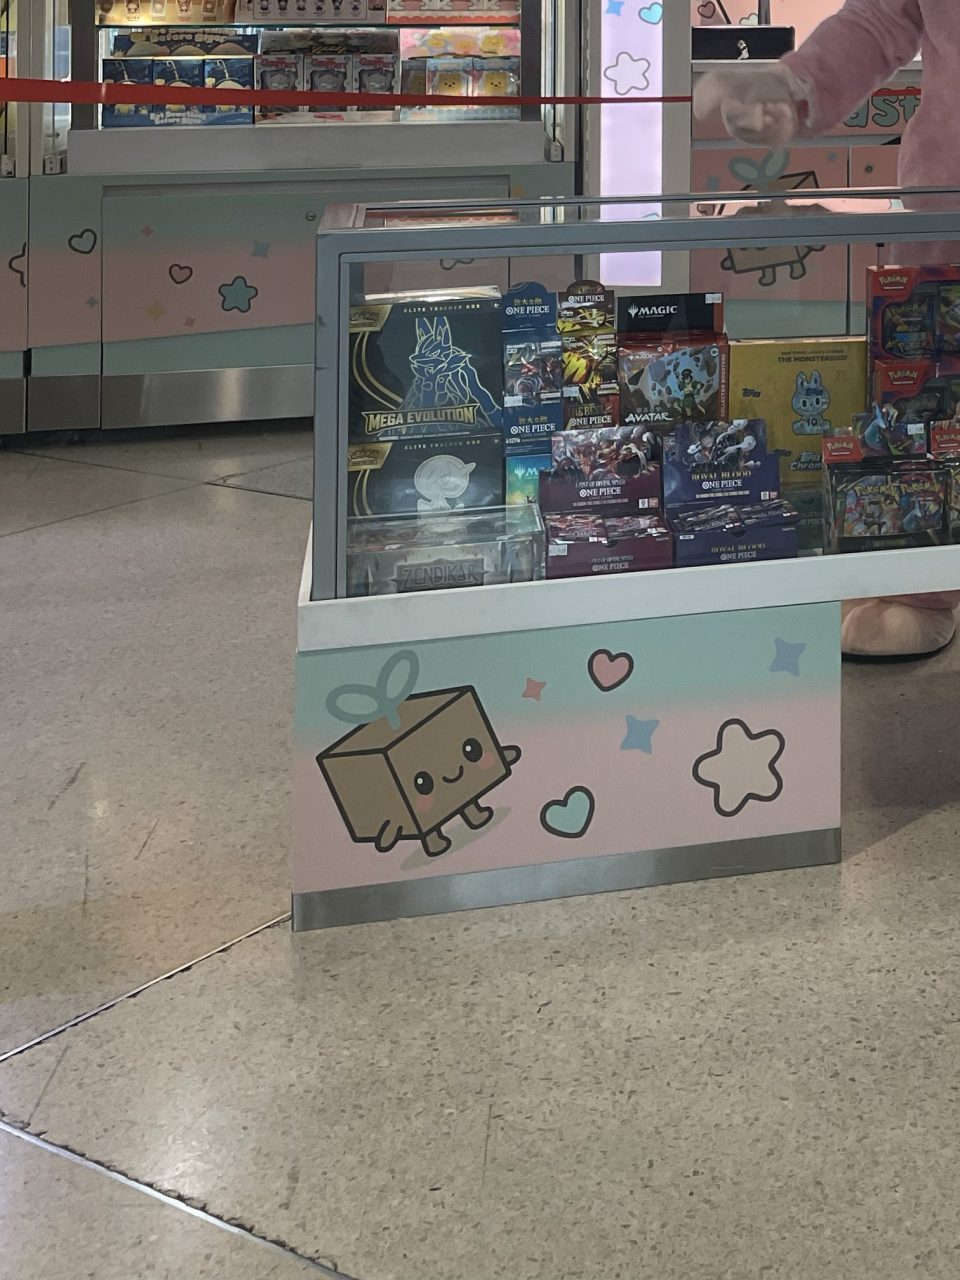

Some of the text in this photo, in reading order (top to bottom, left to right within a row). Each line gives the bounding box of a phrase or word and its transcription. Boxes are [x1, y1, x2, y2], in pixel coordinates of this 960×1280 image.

[505, 305, 550, 315] ONE PIECE
[638, 305, 678, 315] MAGIC
[368, 406, 476, 432] MEGA EVOLUTION
[569, 415, 612, 427] ONE PIECE
[624, 412, 674, 423] AVATAR
[510, 423, 556, 435] ONE PIECE
[791, 461, 824, 471] Chrom
[702, 479, 742, 490] ONE PIECE
[580, 487, 621, 497] ONE PIECE
[402, 564, 477, 588] ZENDIKAR
